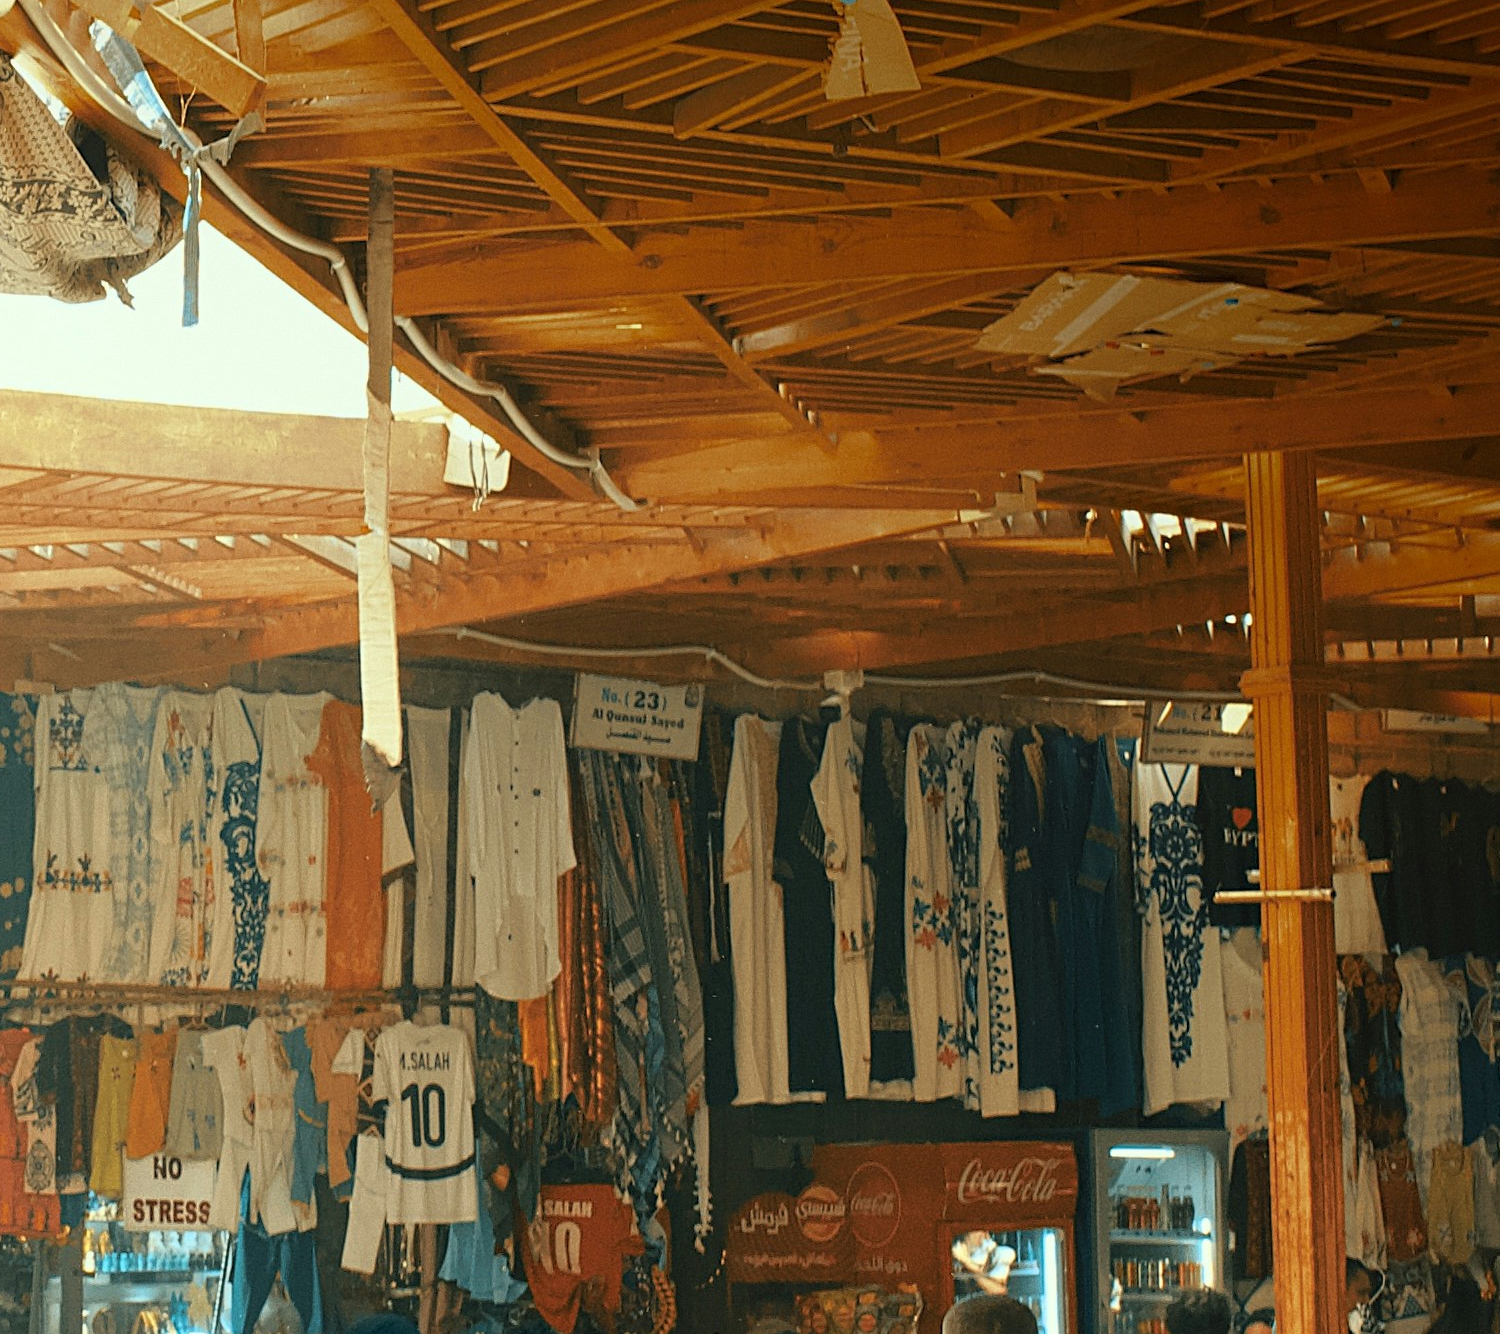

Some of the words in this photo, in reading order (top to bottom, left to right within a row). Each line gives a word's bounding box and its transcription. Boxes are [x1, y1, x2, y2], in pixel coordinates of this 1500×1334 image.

[401, 1083, 446, 1148] 10
[153, 1155, 182, 1180] NO
[957, 1158, 1061, 1205] Coca-Cola
[132, 1198, 212, 1224] STRESS
